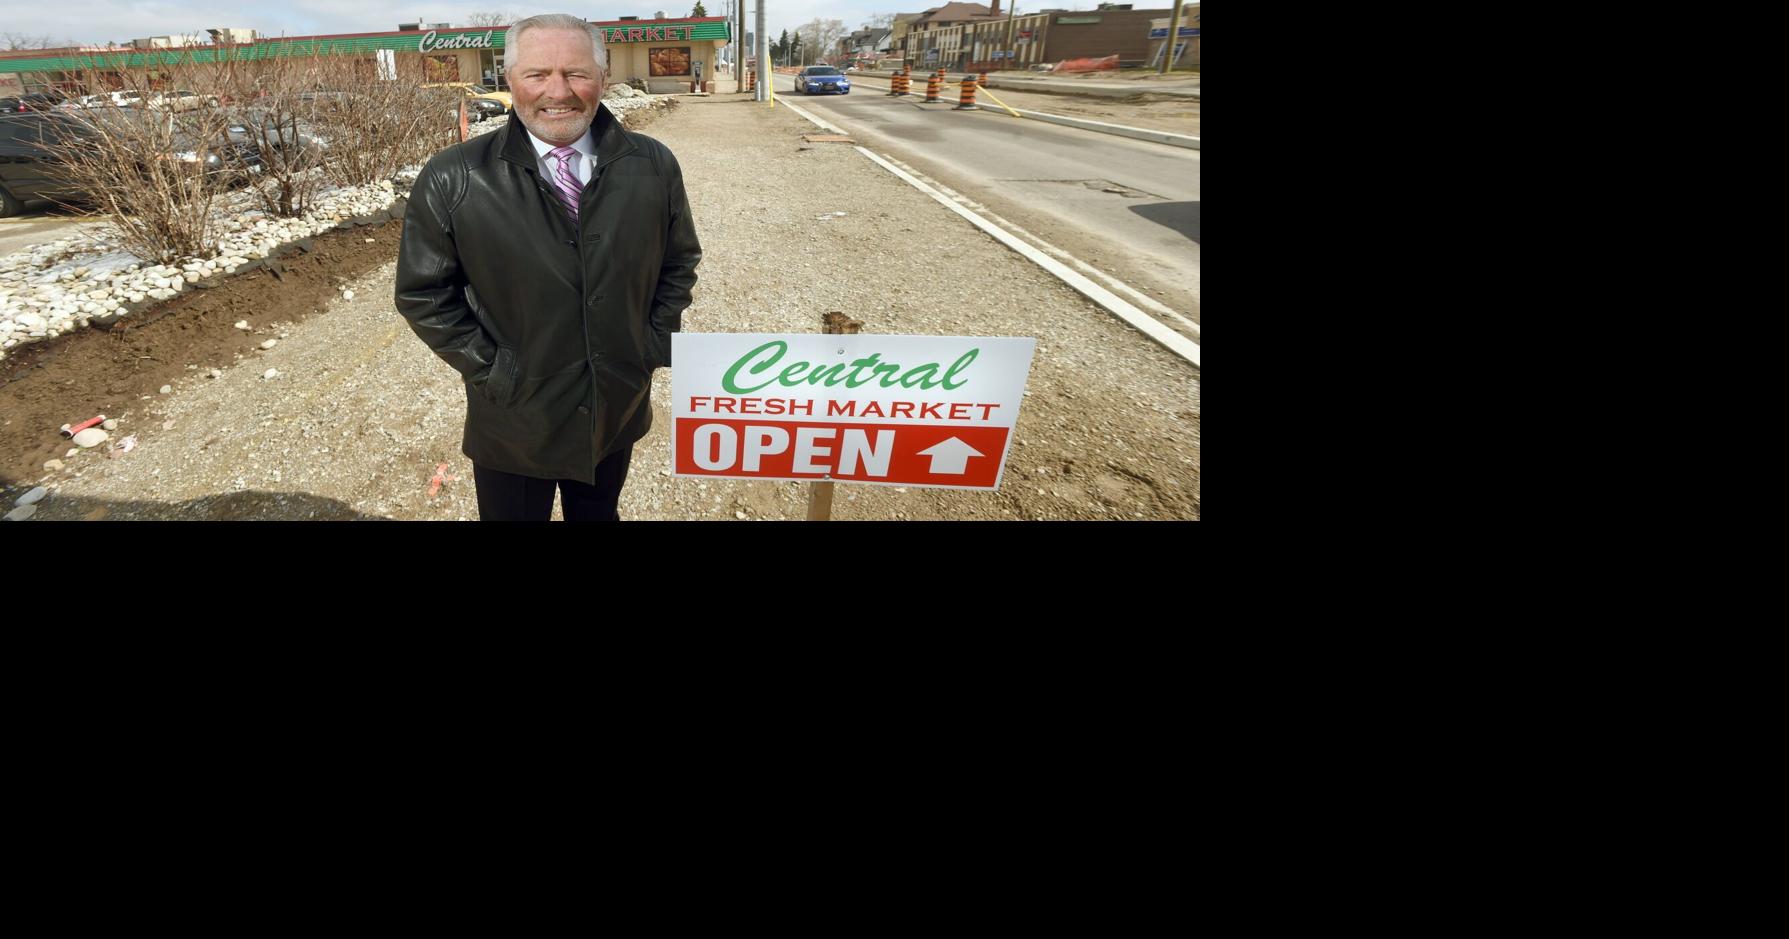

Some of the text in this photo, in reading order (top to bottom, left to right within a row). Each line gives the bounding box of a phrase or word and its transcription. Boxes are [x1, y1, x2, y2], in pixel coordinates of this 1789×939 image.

[419, 30, 492, 53] Central
[721, 340, 980, 394] Central
[690, 396, 1000, 421] FRESH MARKET
[692, 423, 896, 478] OPEN
